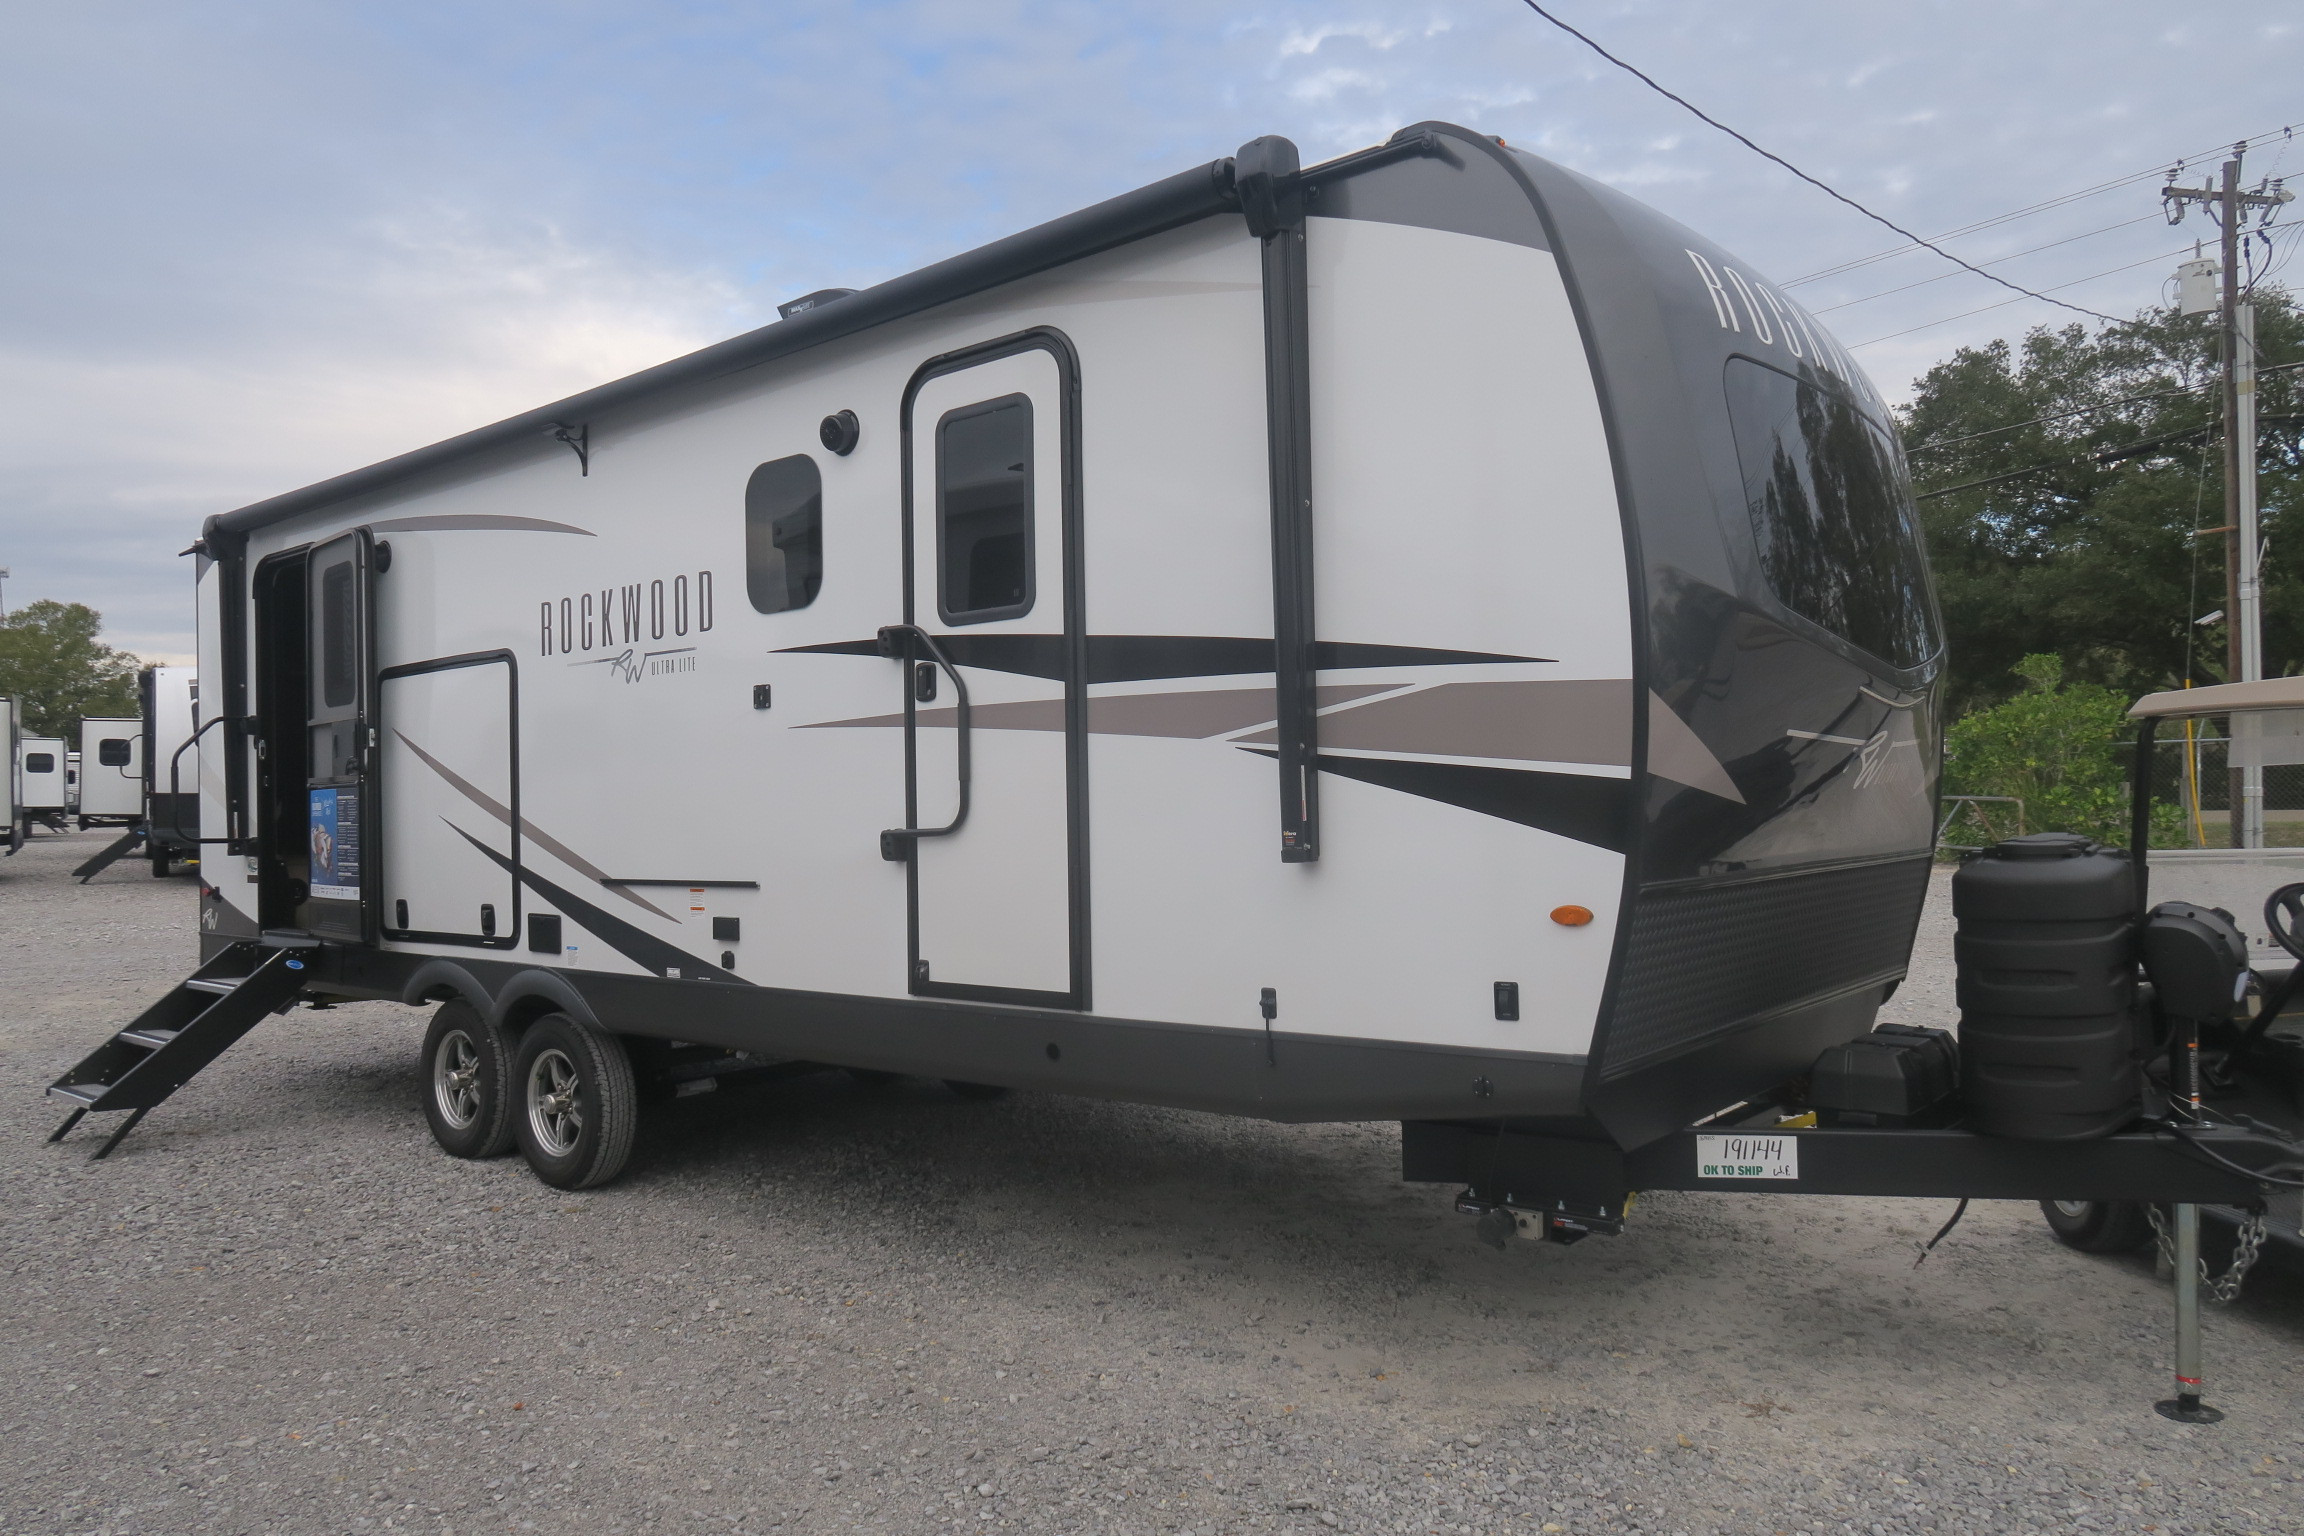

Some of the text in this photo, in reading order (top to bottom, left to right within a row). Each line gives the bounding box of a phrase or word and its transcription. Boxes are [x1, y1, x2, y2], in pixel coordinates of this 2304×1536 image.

[541, 570, 713, 657] ROCKWOOD
[651, 656, 696, 676] ULTRA LITE
[1724, 1138, 1783, 1160] 191144
[1703, 1164, 1764, 1176] OK TO SHIP
